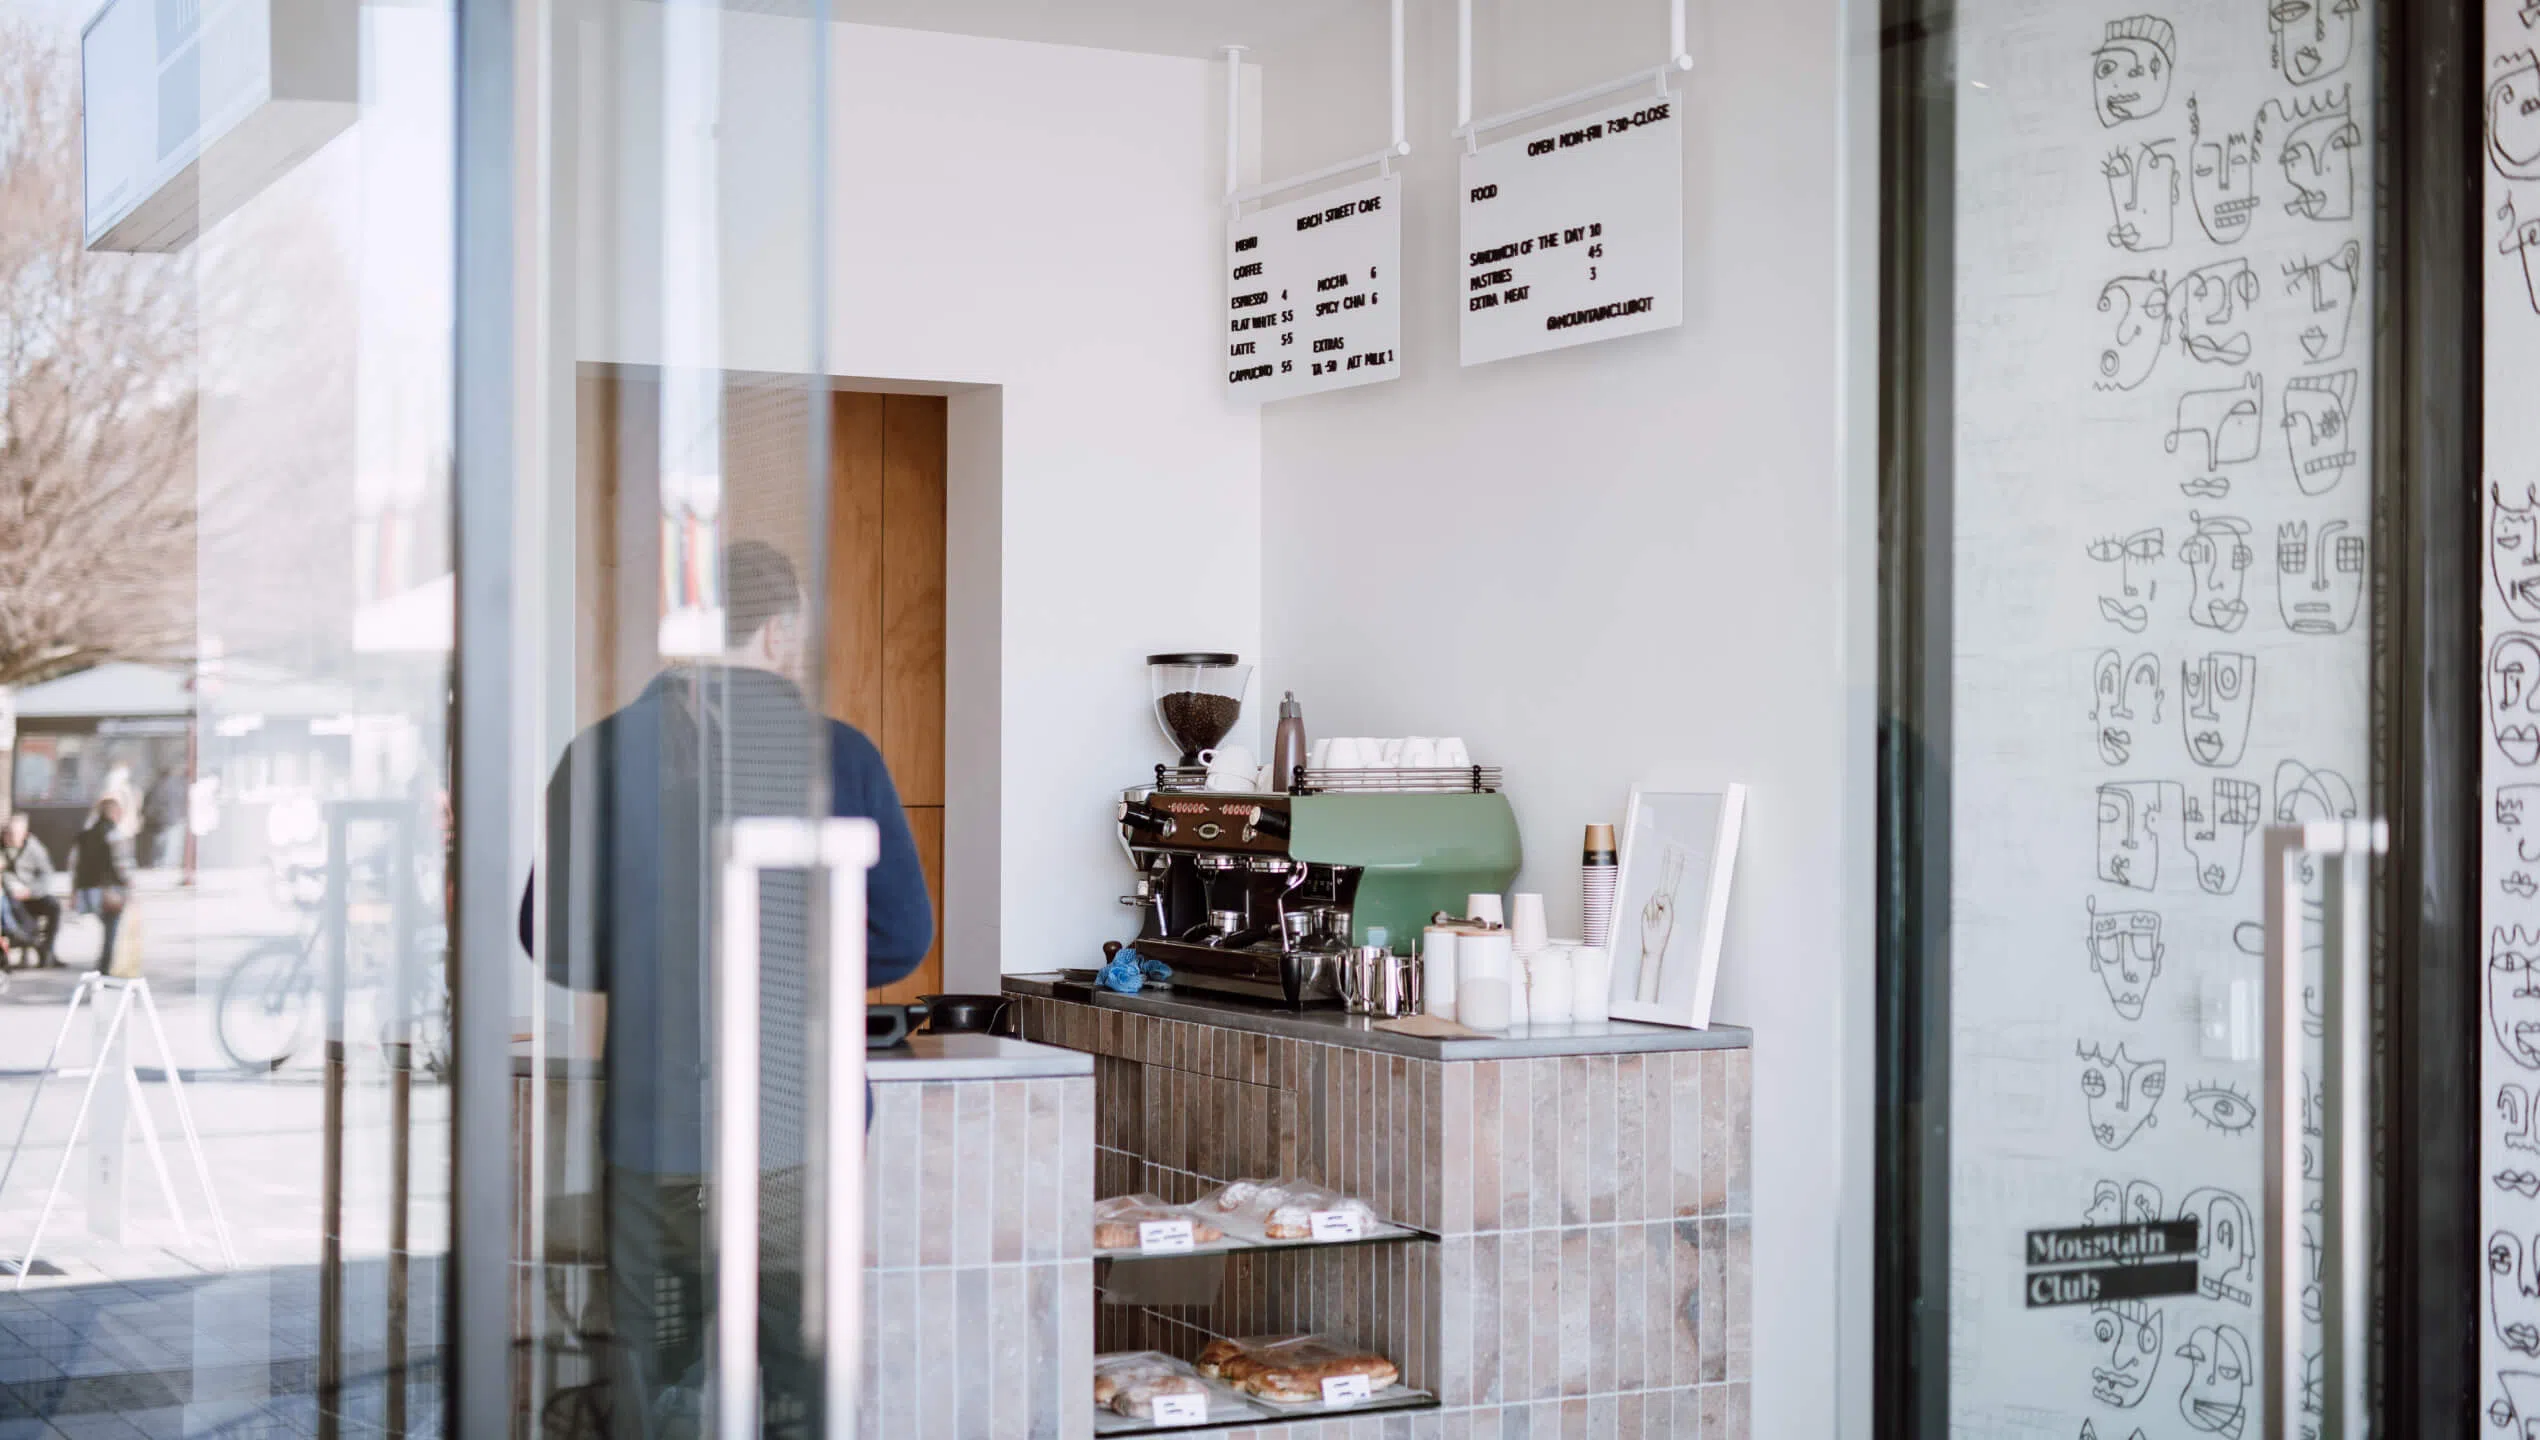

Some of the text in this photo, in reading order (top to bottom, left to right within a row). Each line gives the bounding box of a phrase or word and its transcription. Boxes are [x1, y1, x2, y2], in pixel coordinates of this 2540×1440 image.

[1527, 137, 1556, 158] OPEN
[1558, 123, 1603, 149] MON-FRI
[1470, 183, 1498, 204] FOOD
[1324, 201, 1357, 223] STREET
[1357, 195, 1382, 214] CAFE
[1234, 235, 1258, 253] MENU
[1469, 222, 1602, 268] SANDWICH OF THE DAY 10
[1232, 261, 1263, 281] COFFEE
[1316, 266, 1377, 293] MOCHA 6
[1469, 268, 1513, 292] PASTRIES
[1231, 289, 1288, 310] ESPRESSO 4
[1469, 266, 1597, 312] EXTRA MEAT 3
[1315, 291, 1378, 317] SPICY CHAI 6
[1230, 317, 1251, 333] FLAT
[1251, 312, 1278, 329] WHITE
[1230, 341, 1256, 357] LATTE
[1312, 336, 1345, 354] EXTRAS
[1311, 362, 1323, 377] TA
[1346, 354, 1363, 371] ALT
[1364, 351, 1386, 367] MILK
[1387, 349, 1394, 362] 1
[2032, 1226, 2166, 1263] Mountain
[2031, 1273, 2101, 1304] Club
